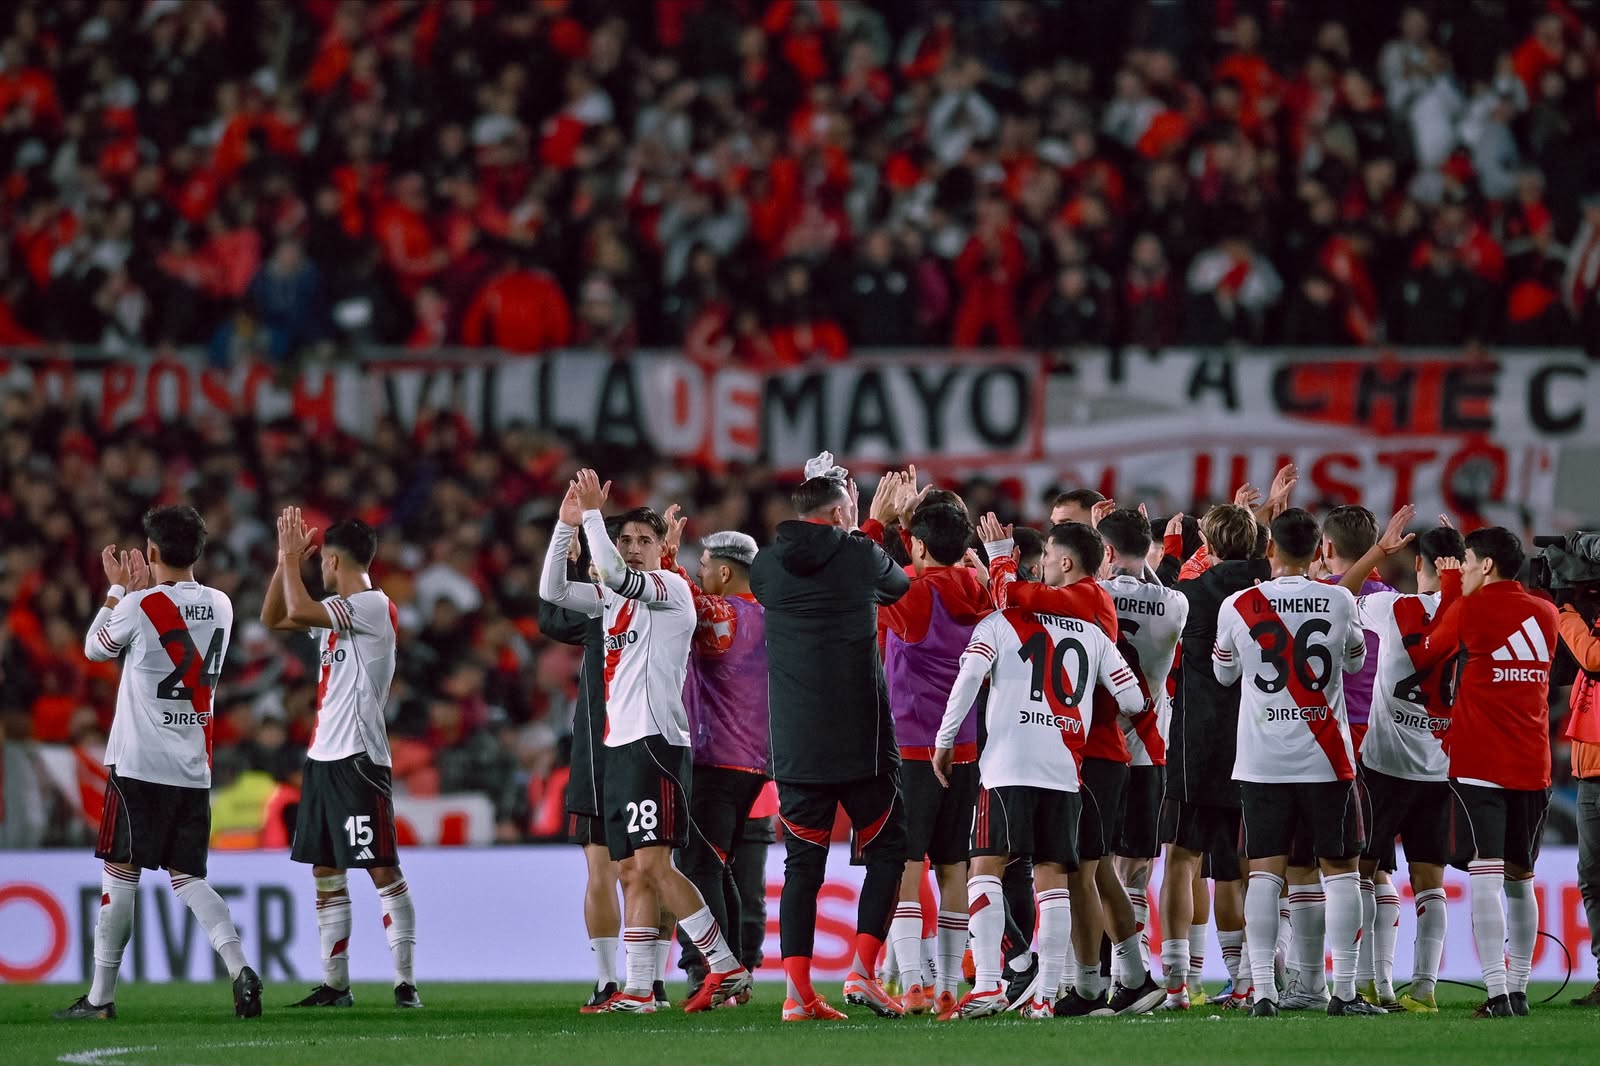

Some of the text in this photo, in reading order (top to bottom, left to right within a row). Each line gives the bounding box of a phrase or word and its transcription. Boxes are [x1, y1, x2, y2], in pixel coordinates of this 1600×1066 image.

[763, 362, 1031, 462] MAYO
[185, 605, 214, 620] MEZA
[1268, 598, 1331, 613] GIMENEZ
[157, 628, 224, 701] 24
[1018, 632, 1089, 708] 10
[1249, 618, 1333, 694] 36
[1019, 710, 1082, 734] DIRECTV
[1266, 706, 1328, 722] DIRECTV
[1393, 709, 1452, 732] DIRECTV
[344, 815, 374, 847] 15
[626, 799, 658, 834] 28
